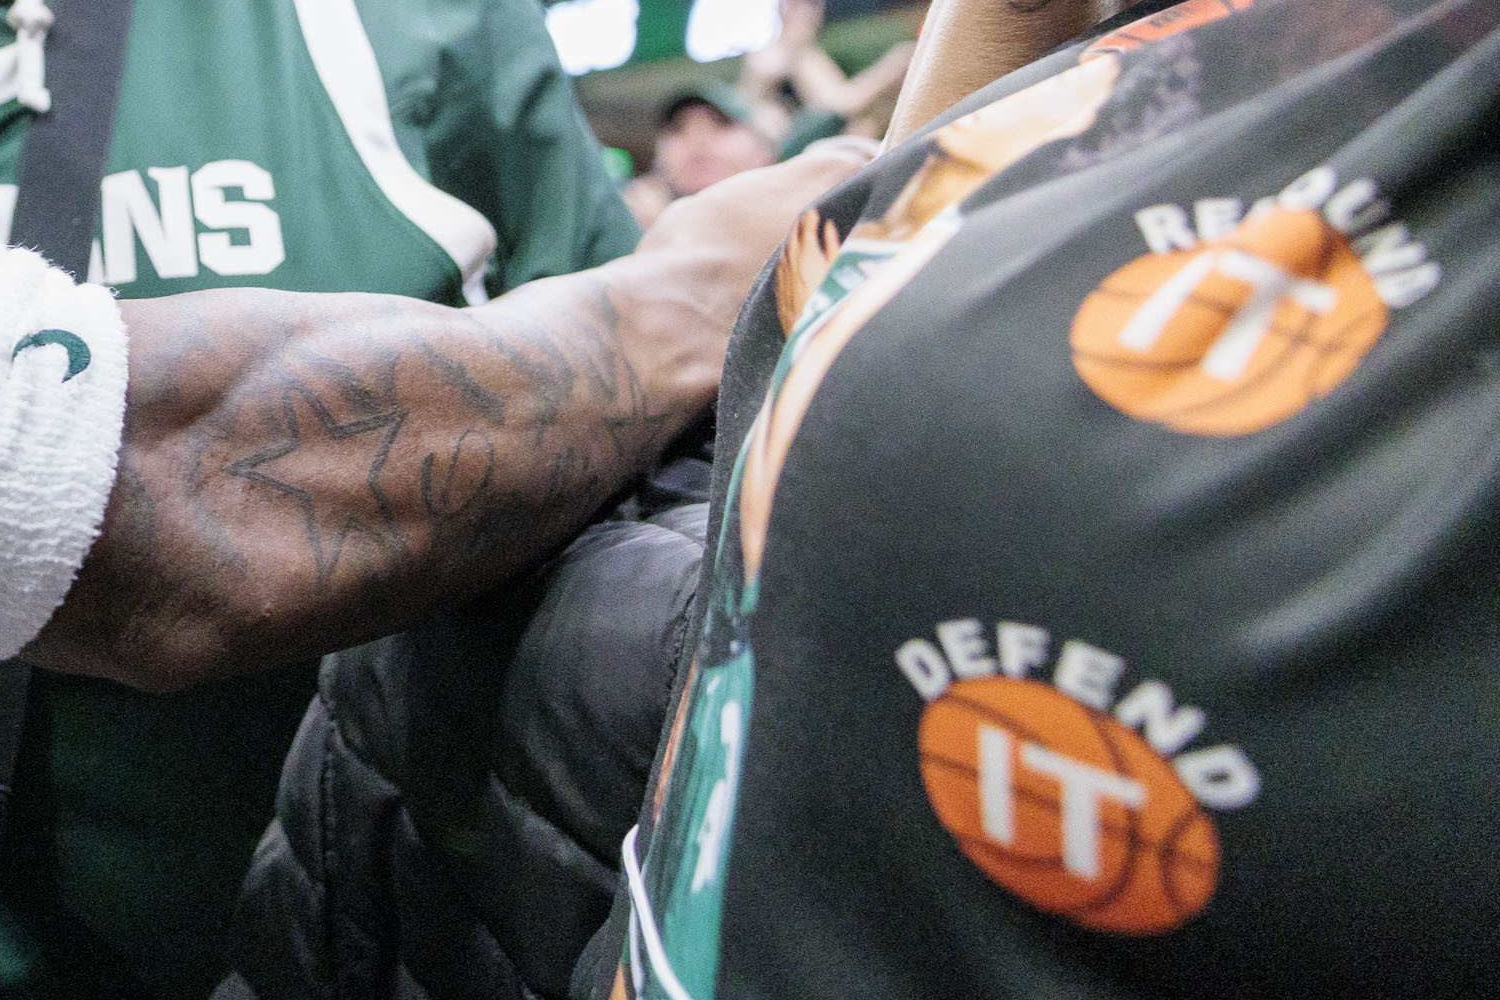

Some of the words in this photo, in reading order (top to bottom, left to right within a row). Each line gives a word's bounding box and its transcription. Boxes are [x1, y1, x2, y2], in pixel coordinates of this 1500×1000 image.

[1118, 249, 1338, 374] IT
[895, 617, 1261, 809] DEFEND
[975, 722, 1149, 884] IT
